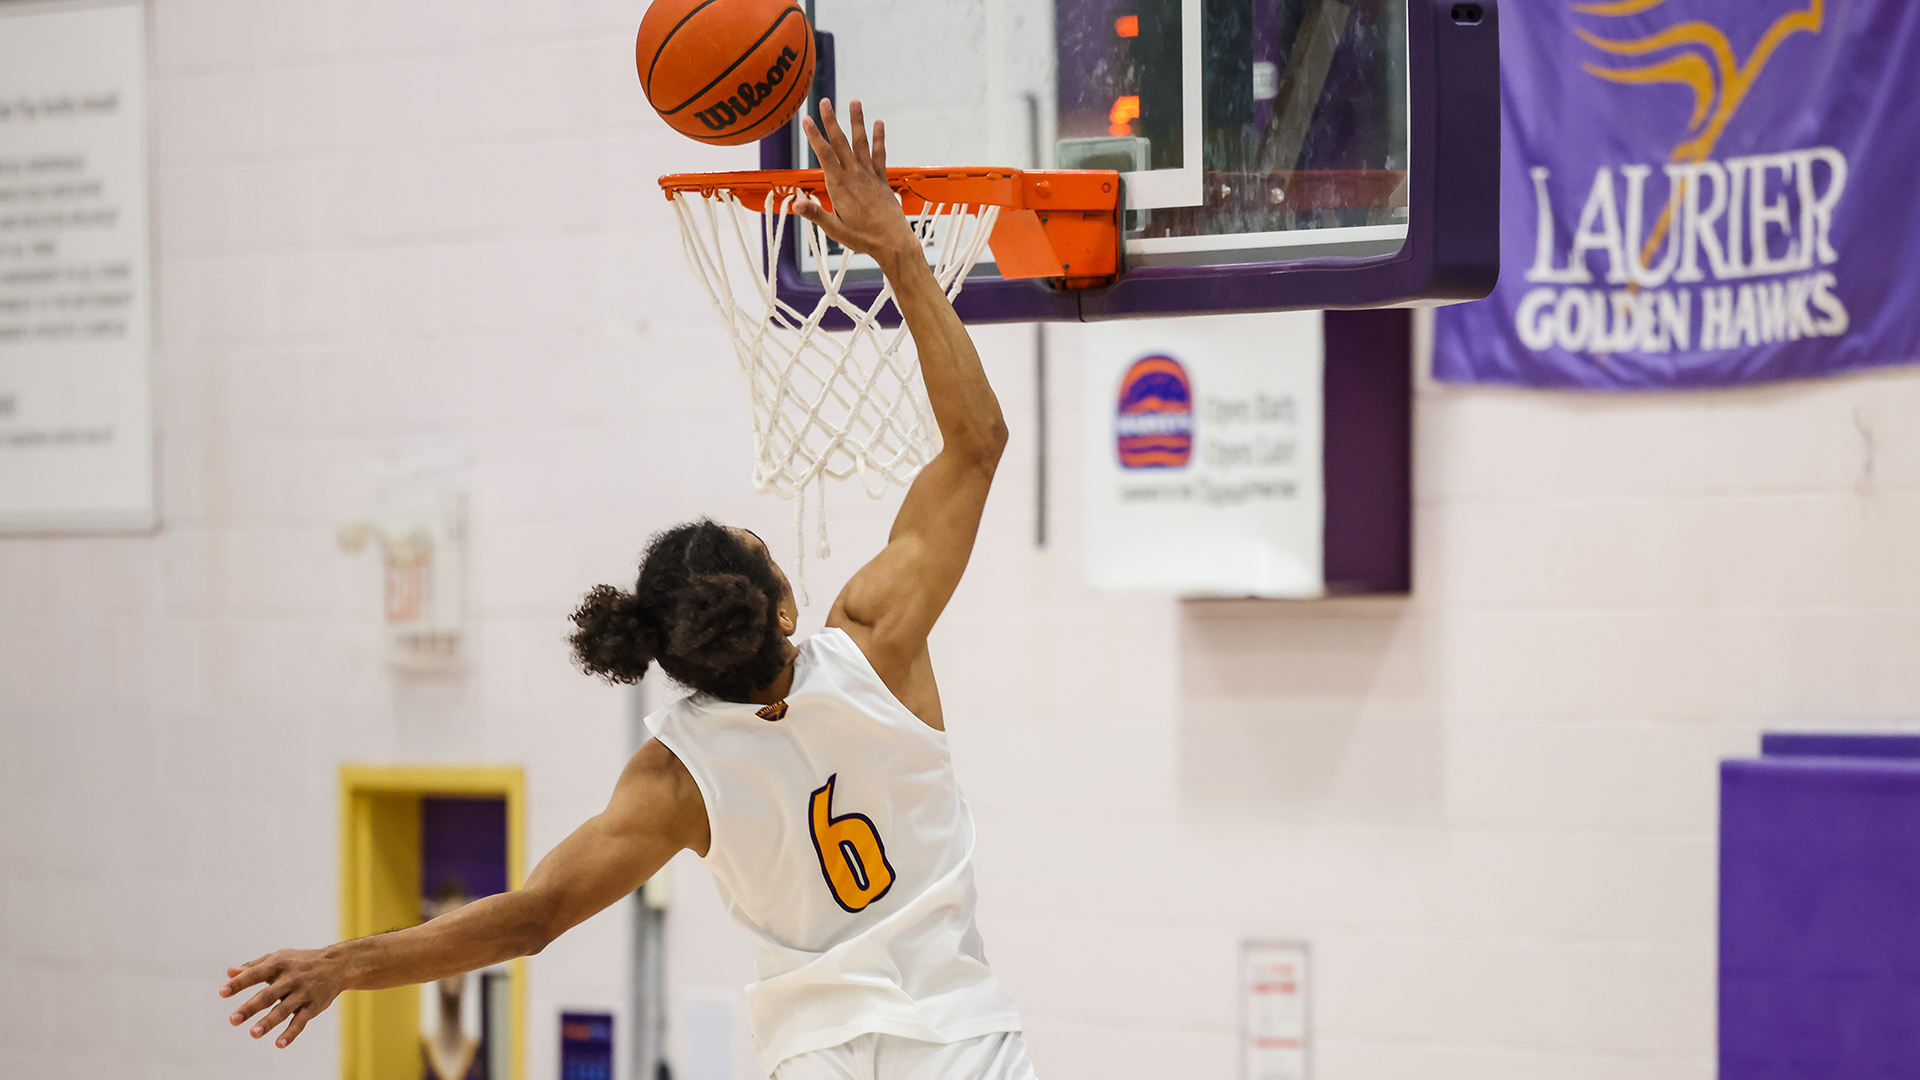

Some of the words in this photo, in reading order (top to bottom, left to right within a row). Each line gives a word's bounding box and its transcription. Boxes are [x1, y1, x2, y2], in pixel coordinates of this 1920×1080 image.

[693, 45, 798, 131] Wilson
[1522, 145, 1848, 287] LAURIER
[1515, 286, 1690, 353] GOLDEN
[1701, 271, 1849, 351] HAWKS
[808, 772, 896, 913] 6
